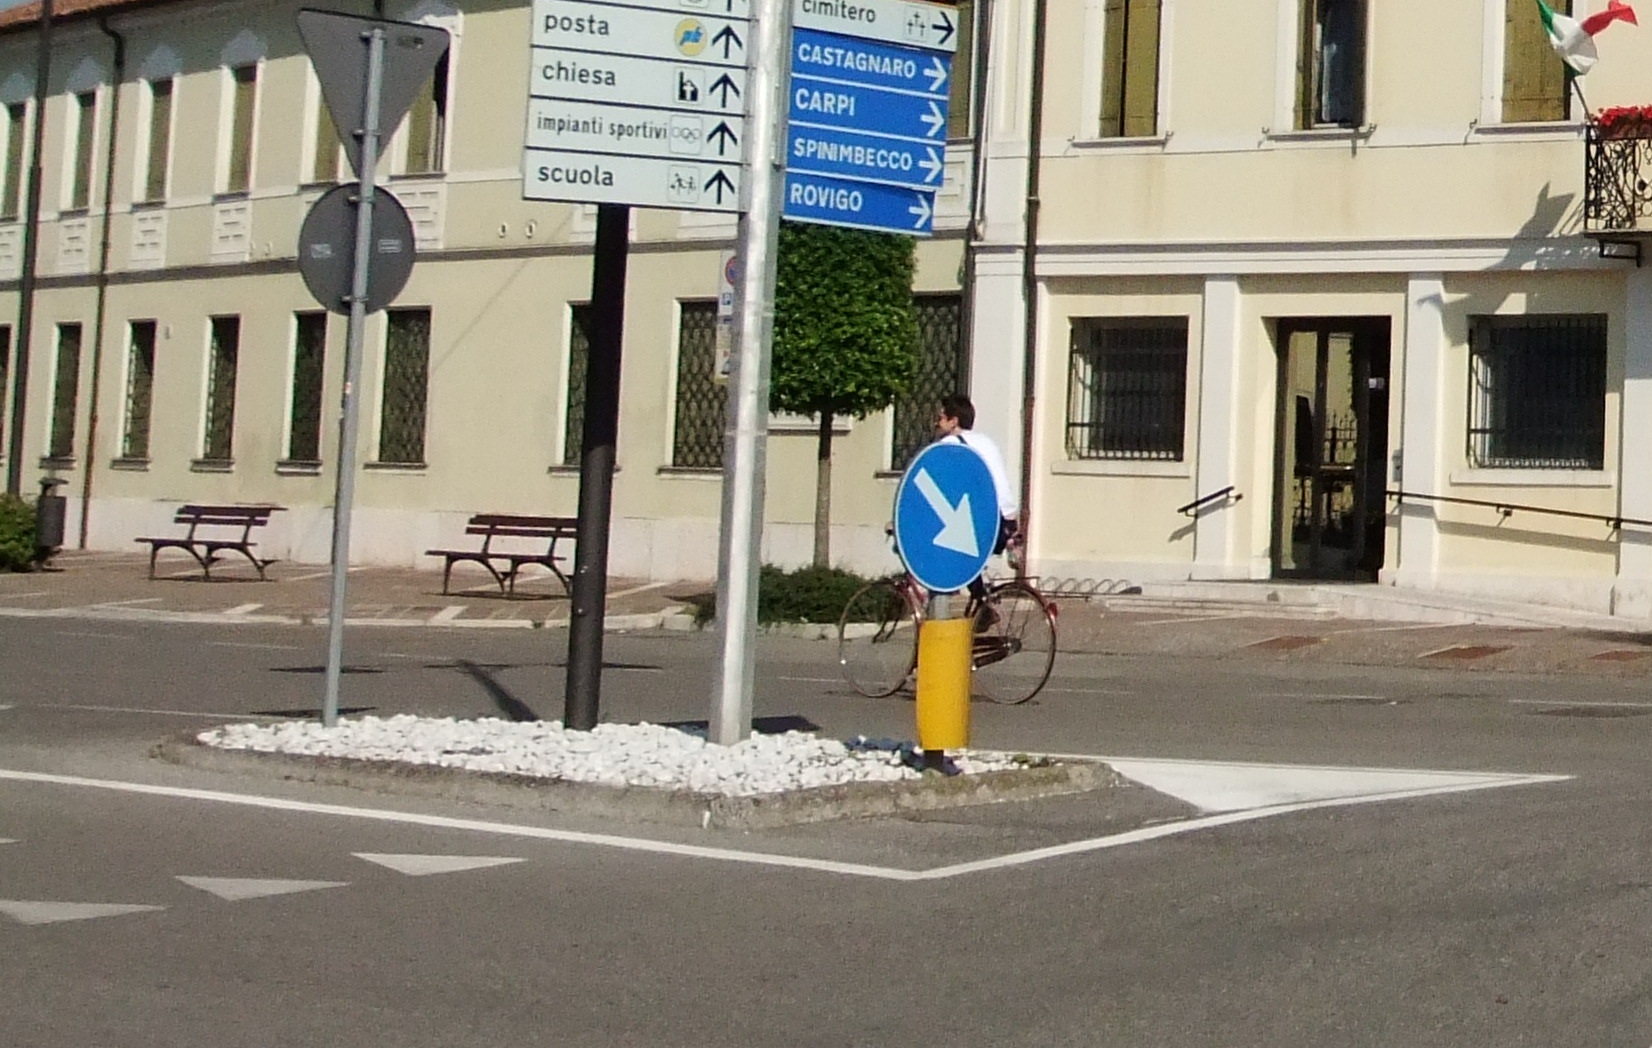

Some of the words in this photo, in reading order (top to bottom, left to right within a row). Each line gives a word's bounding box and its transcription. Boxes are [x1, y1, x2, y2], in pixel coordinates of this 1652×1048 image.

[543, 10, 610, 37] posta
[541, 62, 616, 87] chiesa
[797, 44, 916, 79] CASTAGNARO
[795, 88, 855, 117] CARPI
[536, 111, 603, 140] impianti
[608, 119, 668, 145] sportivi
[793, 138, 913, 172] SPINIMBECCO
[537, 161, 614, 188] scuola
[790, 185, 863, 213] ROVIGO
